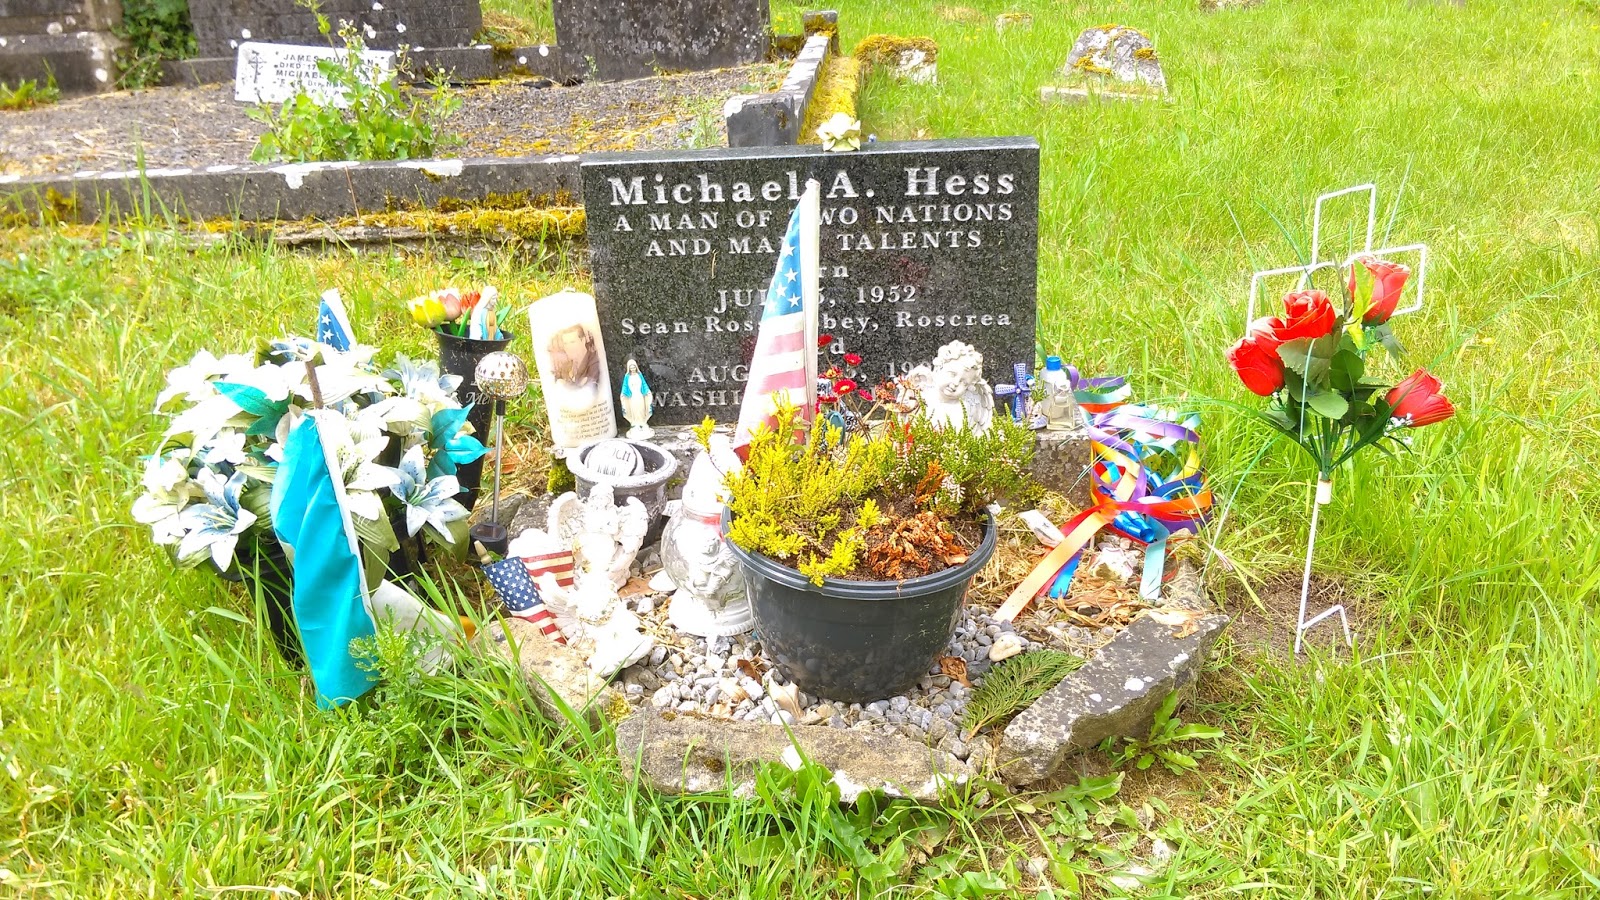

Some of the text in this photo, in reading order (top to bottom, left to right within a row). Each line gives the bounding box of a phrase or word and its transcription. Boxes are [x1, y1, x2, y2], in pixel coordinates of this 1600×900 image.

[608, 167, 1014, 206] Michael A. Hess
[613, 203, 1013, 232] A MAN OF WO NATIONS
[646, 230, 982, 256] AND MA TALENTS
[856, 285, 916, 303] 1952
[621, 317, 689, 335] Sean
[704, 315, 759, 332] Ros
[895, 311, 1012, 328] Roscrea
